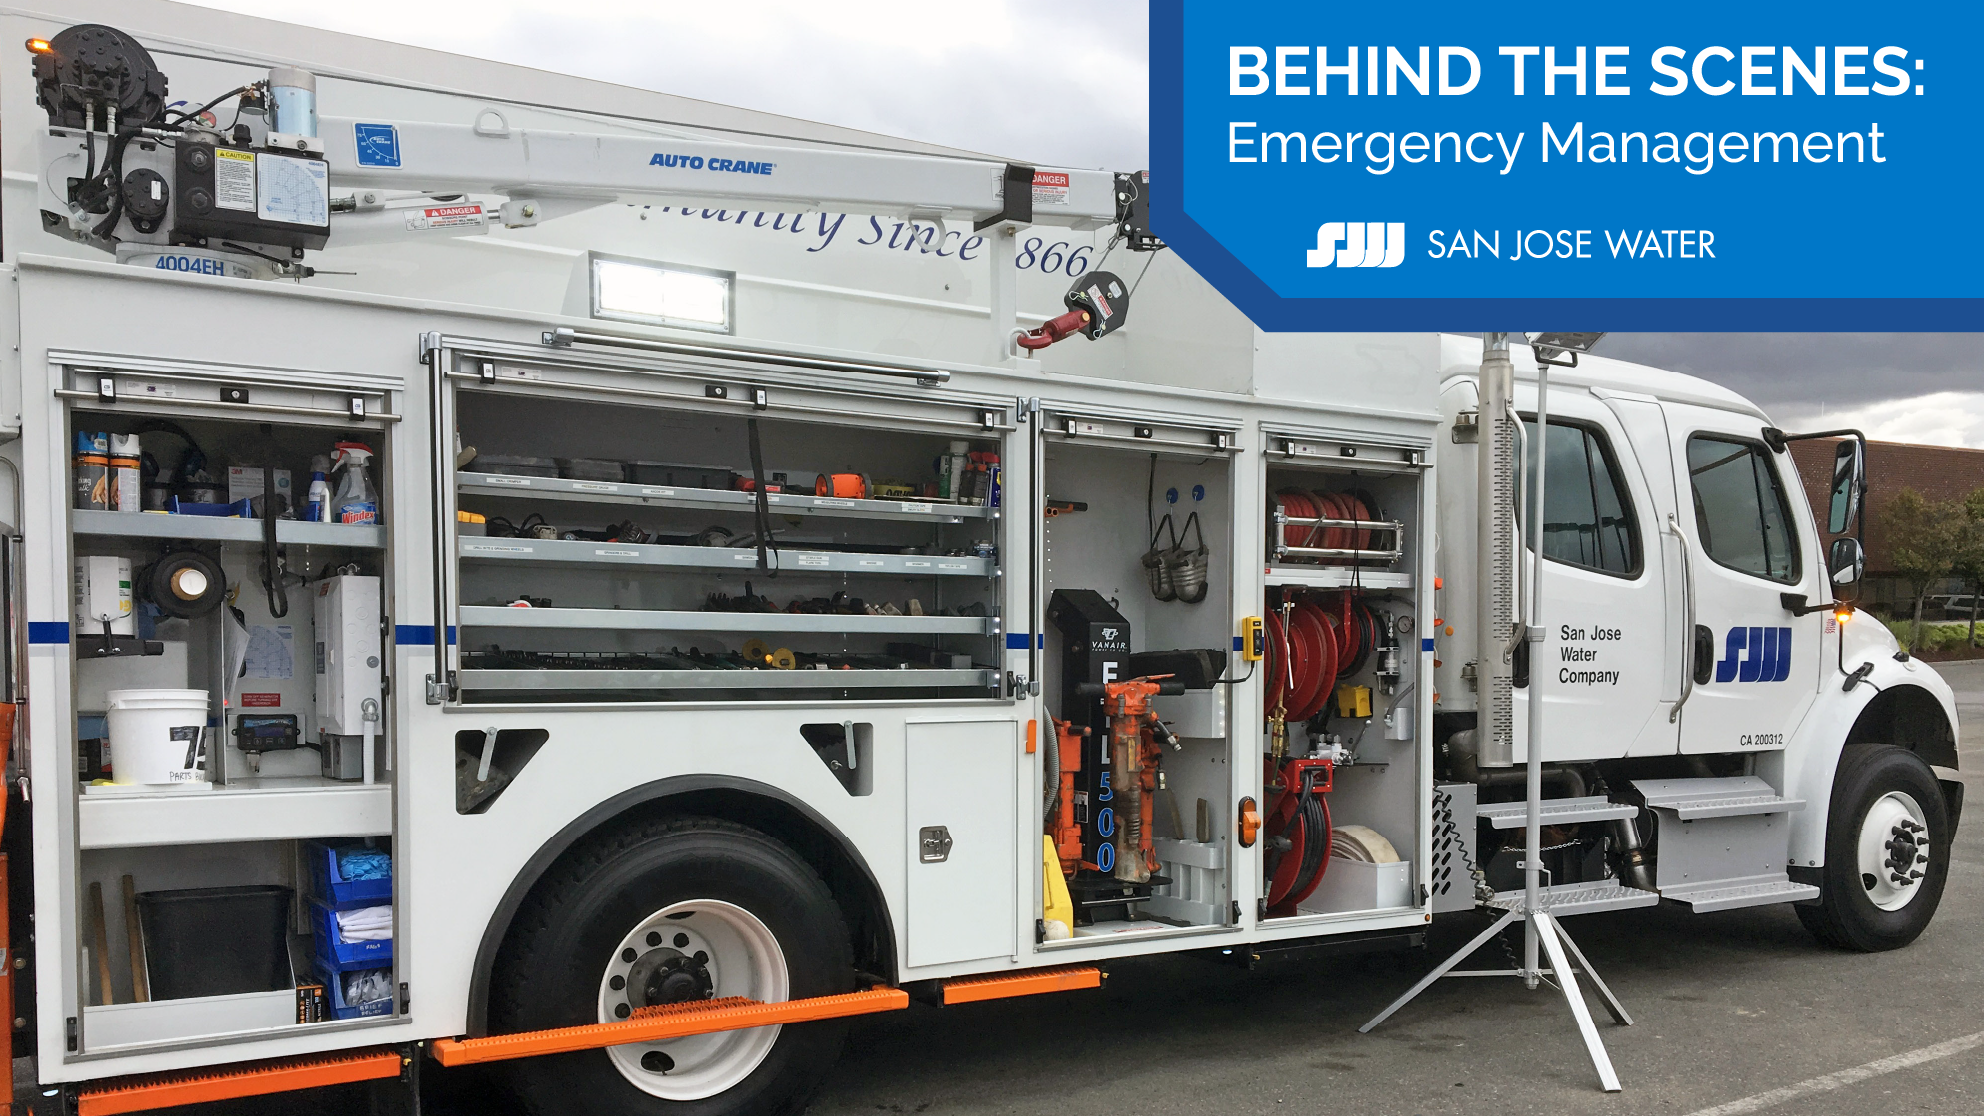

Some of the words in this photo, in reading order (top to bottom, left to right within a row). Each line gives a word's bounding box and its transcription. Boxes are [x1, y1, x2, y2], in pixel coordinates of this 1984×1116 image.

[225, 152, 252, 161] CAUTION
[649, 153, 704, 170] AUTO
[439, 207, 476, 216] DANGER
[857, 215, 983, 261] Since
[1015, 237, 1094, 277] 866
[156, 255, 225, 277] 4004EH
[341, 509, 375, 524] Windex
[1560, 624, 1585, 641] San
[1590, 624, 1622, 642] Jose
[1091, 641, 1126, 649] VANAIR
[1560, 646, 1598, 662] Water
[1558, 667, 1620, 686] Company
[1740, 735, 1752, 746] CA
[1754, 734, 1784, 746] 200312
[169, 771, 192, 782] PARTS
